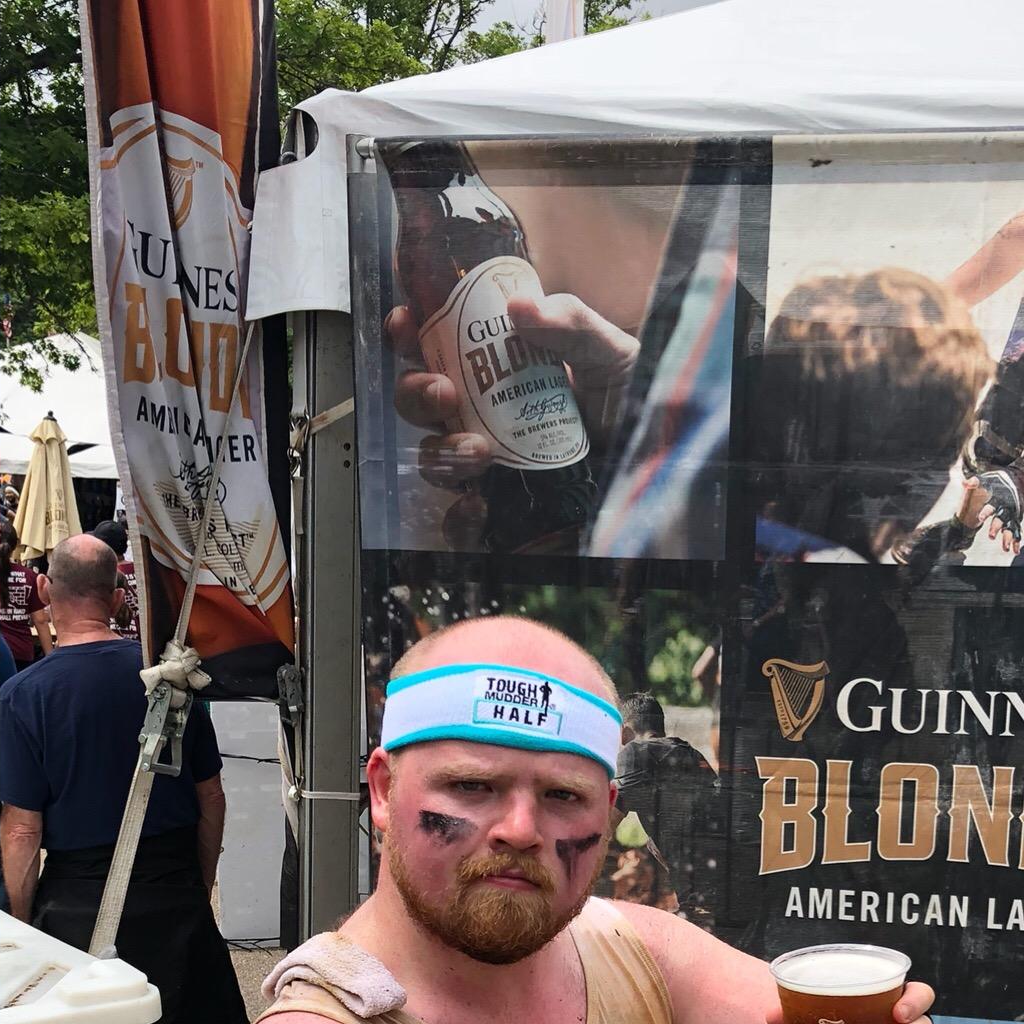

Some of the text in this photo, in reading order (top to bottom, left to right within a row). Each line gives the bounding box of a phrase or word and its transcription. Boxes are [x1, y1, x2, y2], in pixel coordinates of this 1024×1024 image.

[490, 377, 547, 407] AMERICAN
[487, 677, 537, 699] TOUGH
[484, 691, 538, 708] MUDDER
[493, 704, 547, 726] HALF
[784, 886, 970, 928] AMERICAN
